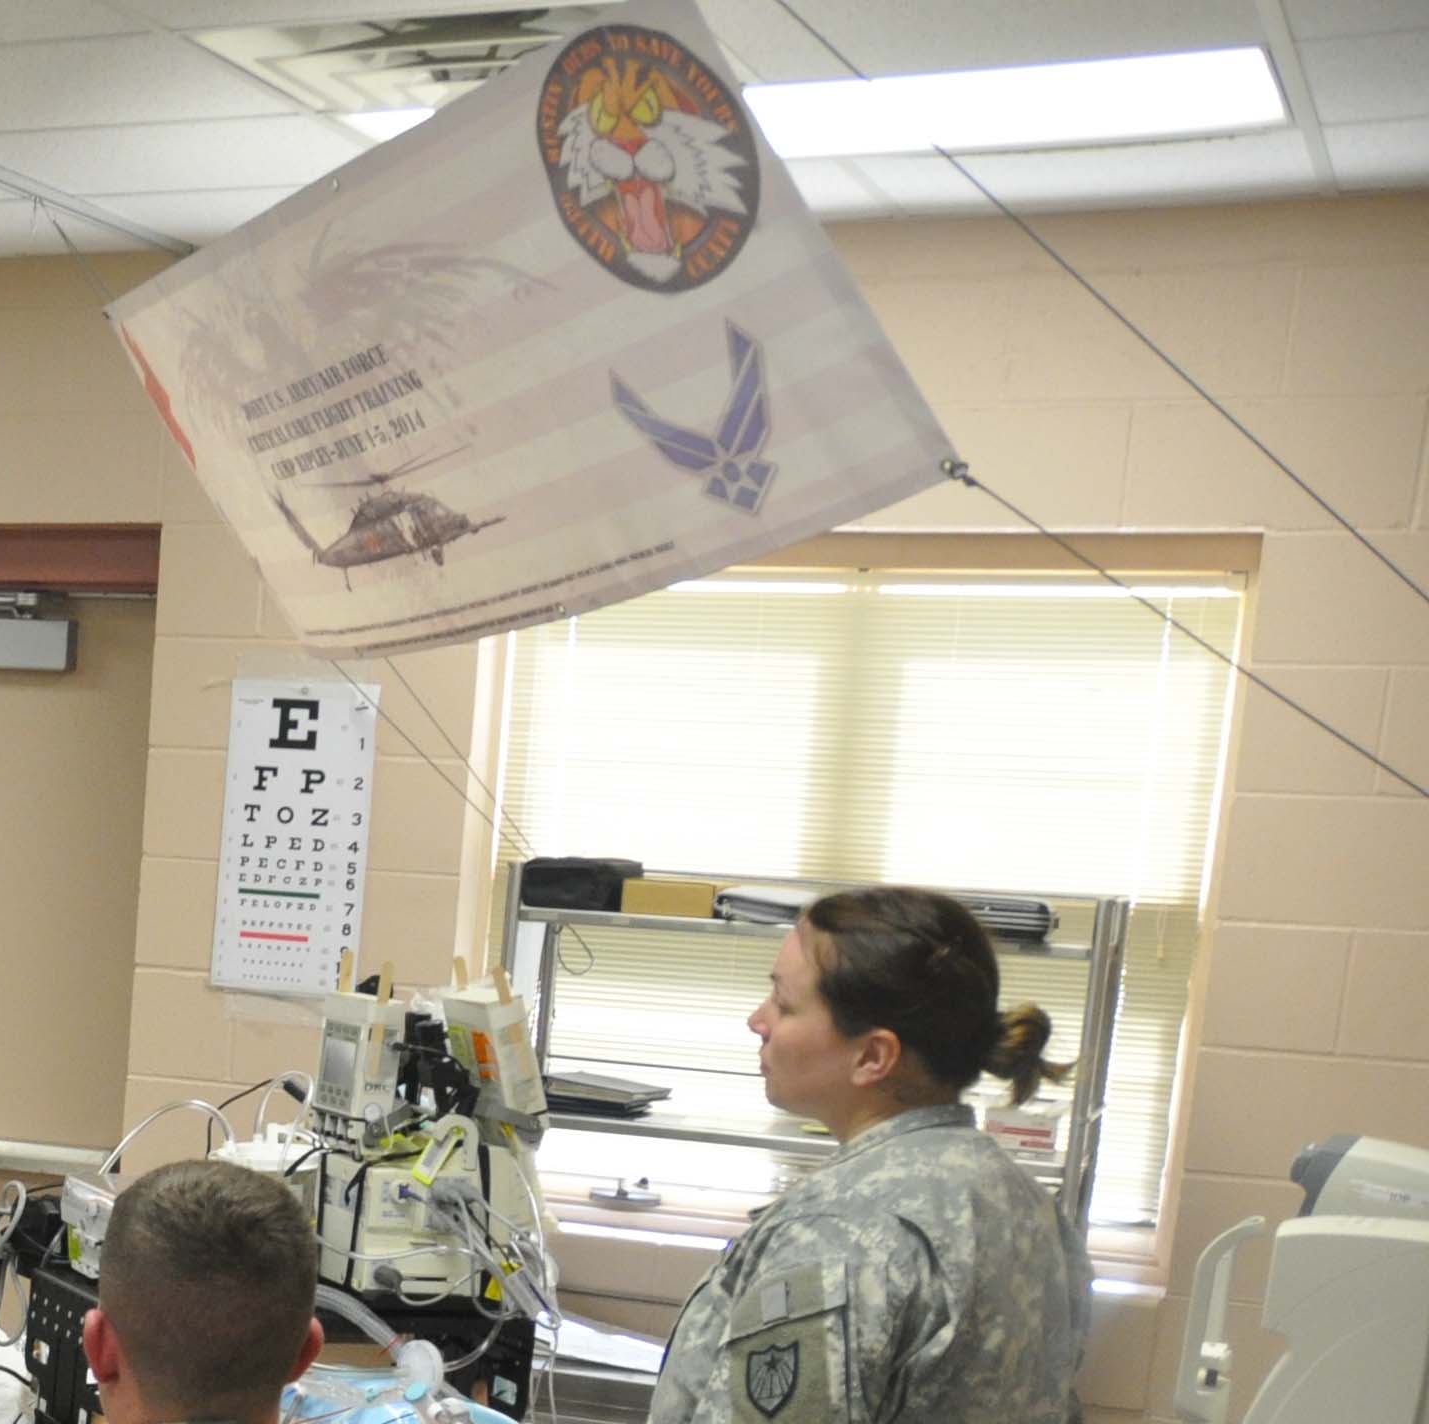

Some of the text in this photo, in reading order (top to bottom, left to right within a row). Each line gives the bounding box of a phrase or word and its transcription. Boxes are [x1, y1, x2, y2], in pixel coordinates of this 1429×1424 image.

[341, 344, 390, 379] FORCE
[312, 399, 356, 431] FLIGHT
[354, 368, 424, 414] TRAINING
[388, 408, 427, 439] 2014
[269, 698, 365, 750] E 1
[253, 766, 364, 793] F P 2
[244, 804, 362, 826] T O Z 3
[241, 834, 359, 853] L P E D 4
[347, 863, 356, 875] 5
[345, 879, 355, 890] 6
[344, 904, 355, 916] 7
[341, 924, 351, 936] 8
